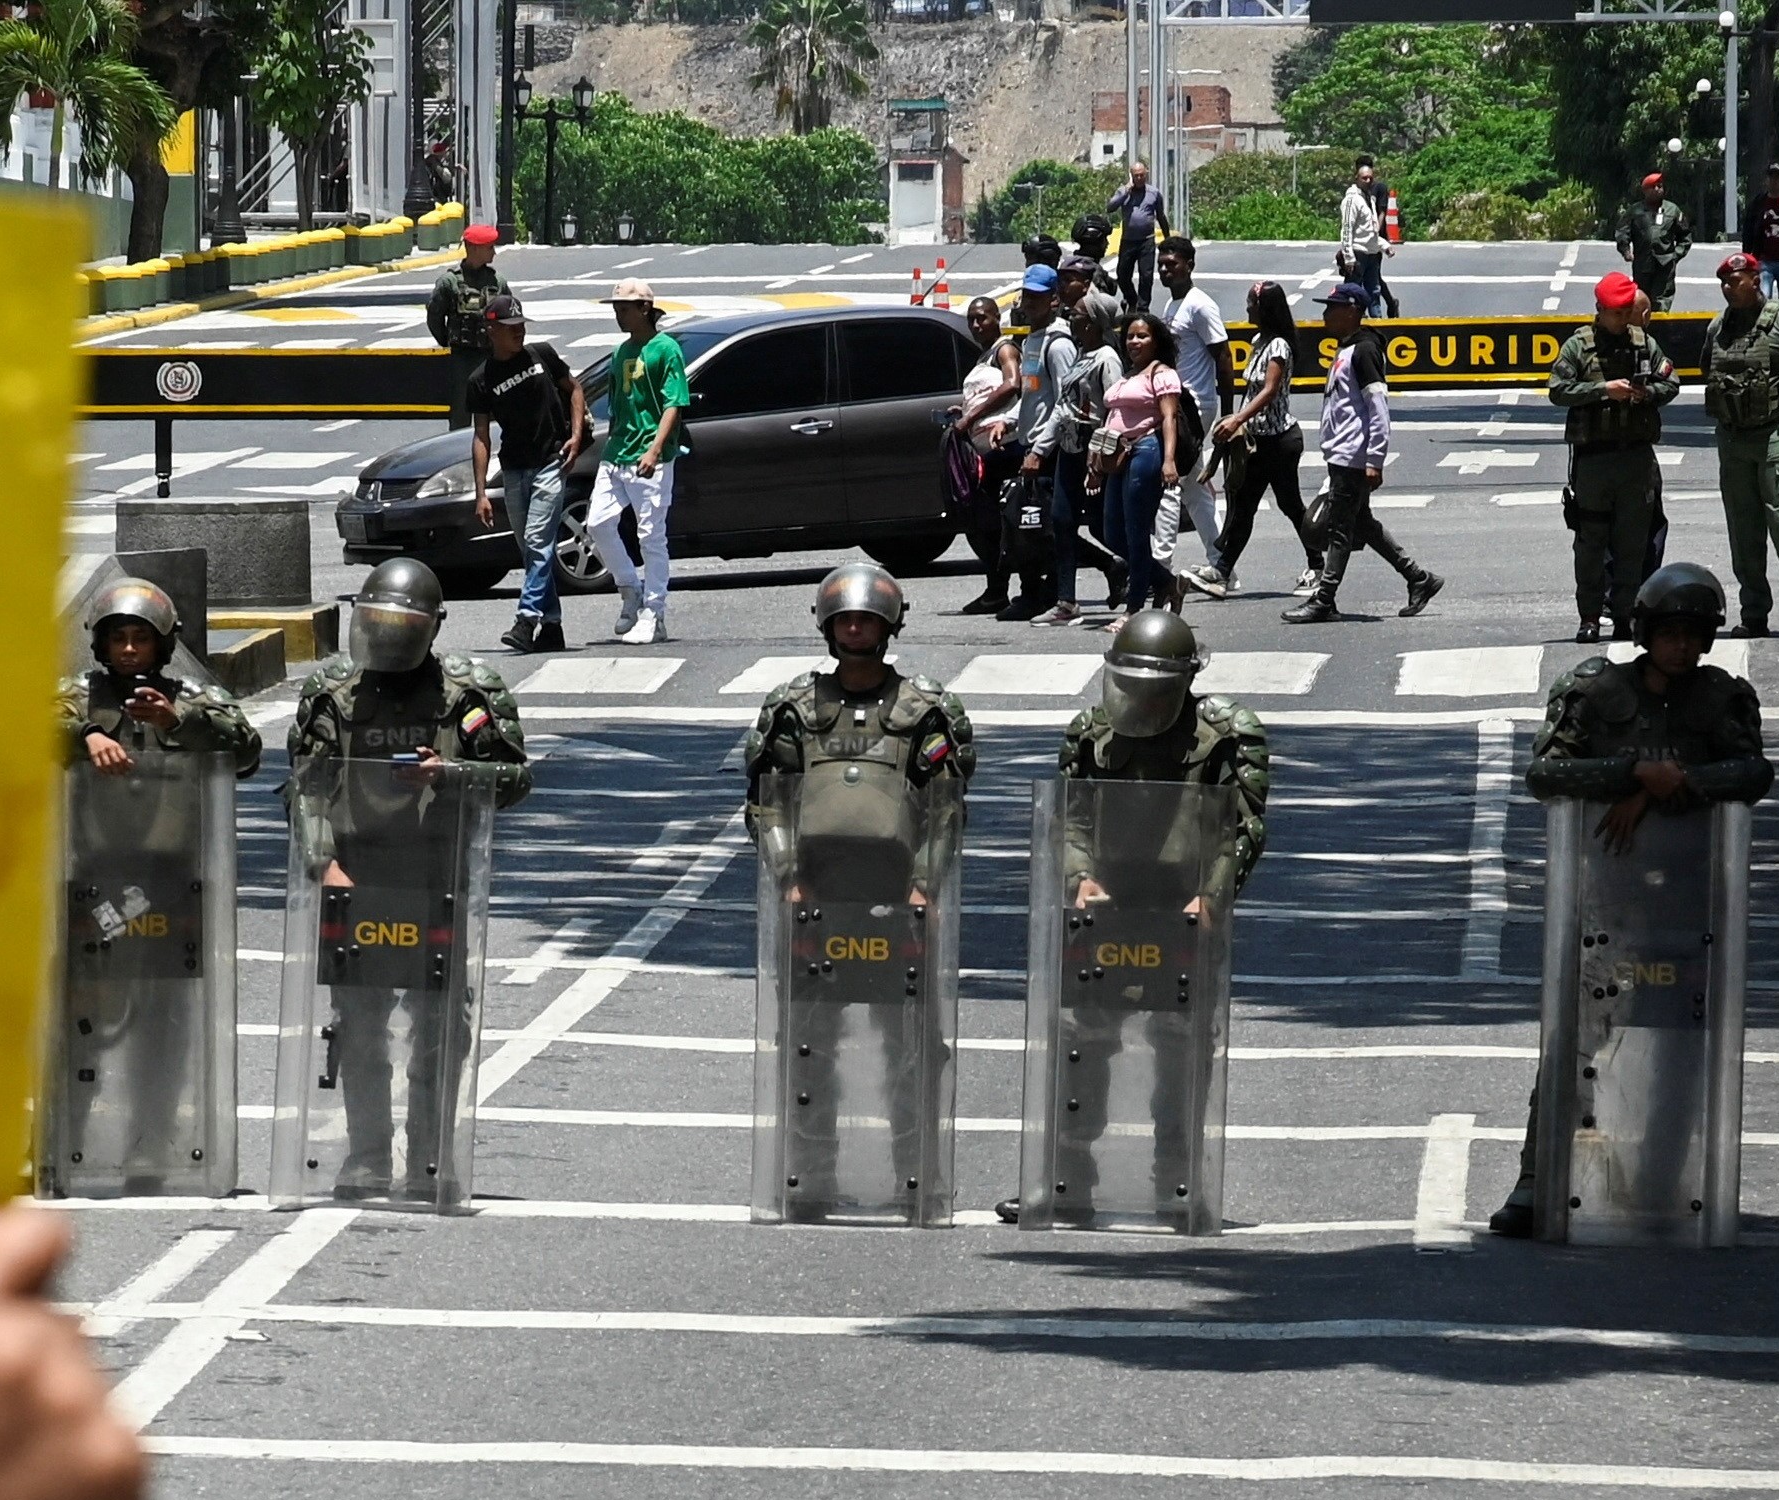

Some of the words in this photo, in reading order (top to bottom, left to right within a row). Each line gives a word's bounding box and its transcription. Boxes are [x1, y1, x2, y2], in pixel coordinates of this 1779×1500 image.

[365, 727, 428, 747] GNB
[354, 921, 419, 946] GNB
[825, 936, 890, 961] GNB
[1095, 942, 1162, 968] GNB
